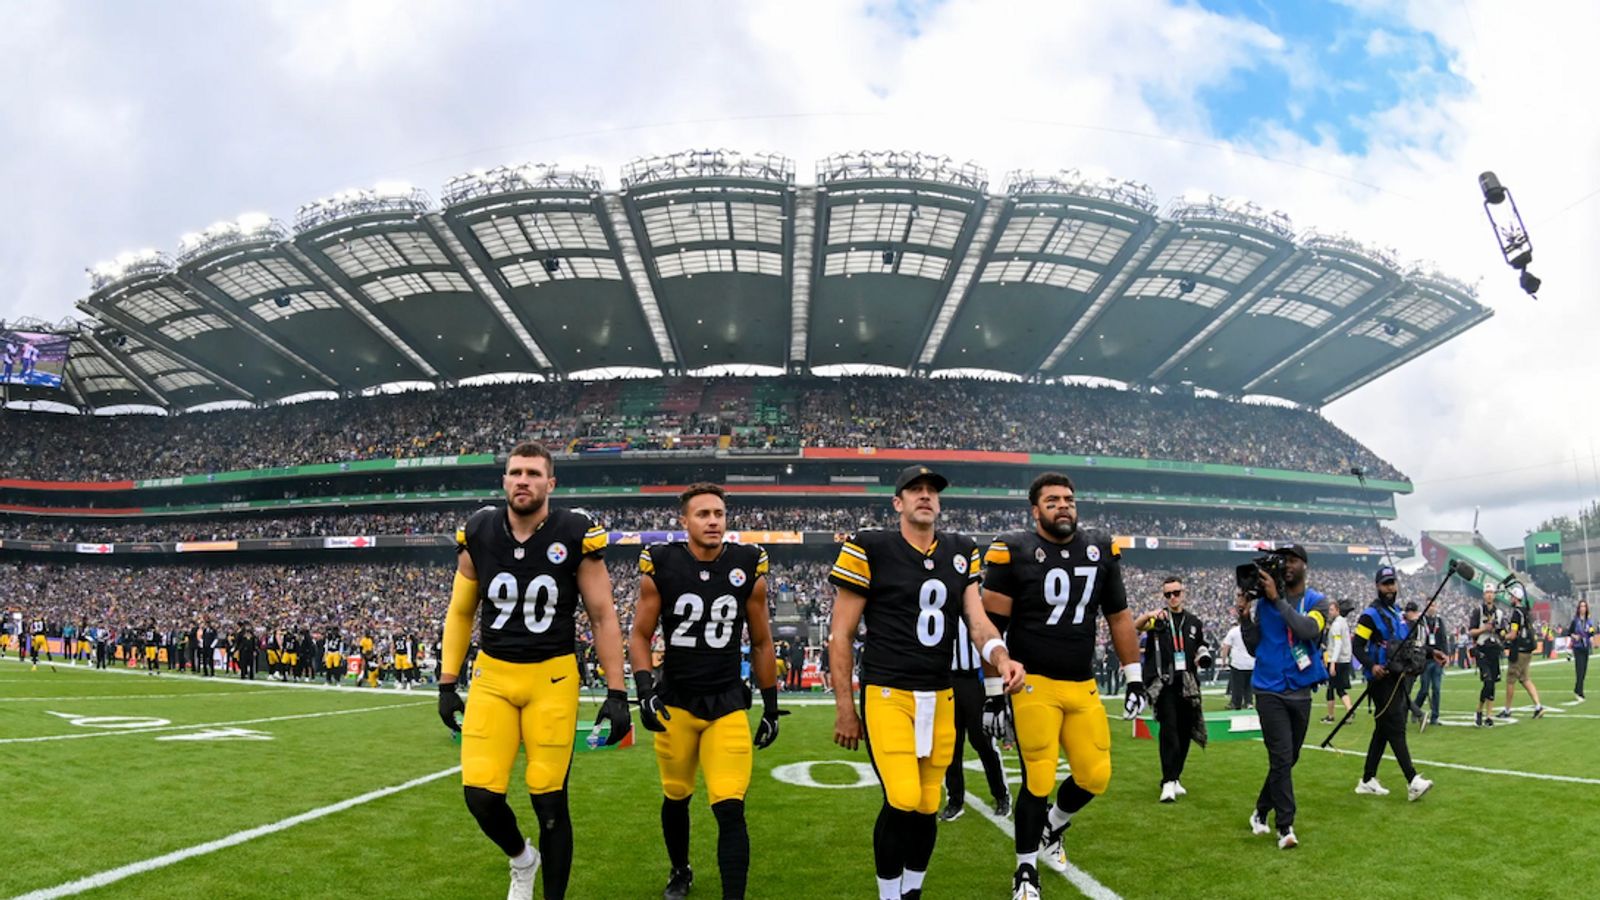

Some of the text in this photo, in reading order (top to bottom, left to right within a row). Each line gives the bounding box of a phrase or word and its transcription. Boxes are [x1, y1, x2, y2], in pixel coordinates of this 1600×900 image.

[487, 571, 559, 634] 90
[670, 592, 738, 649] 28
[916, 578, 948, 647] 8
[1043, 566, 1098, 626] 97
